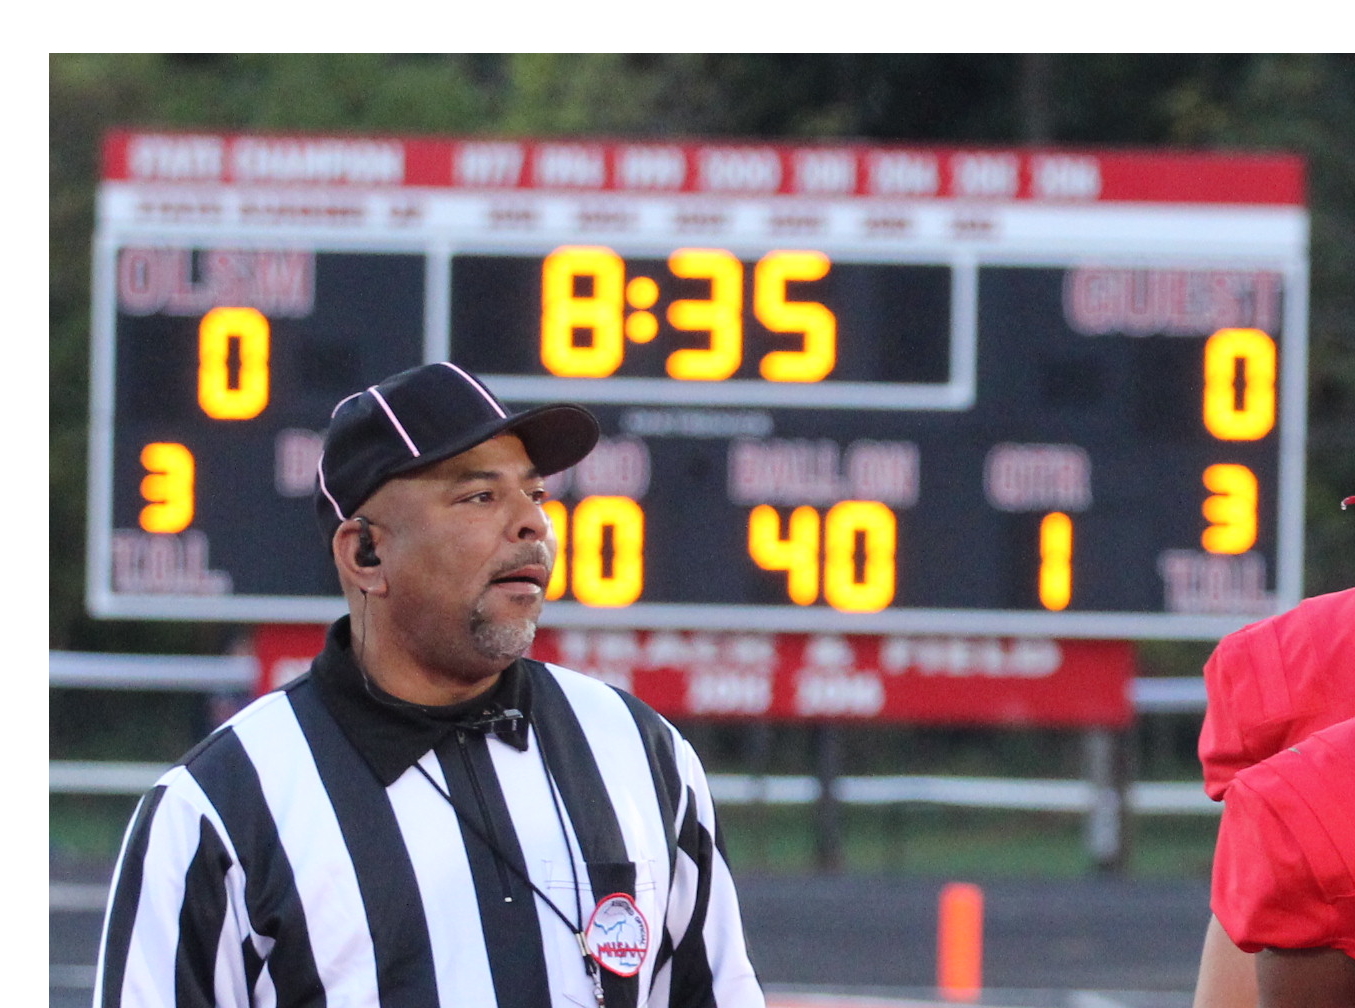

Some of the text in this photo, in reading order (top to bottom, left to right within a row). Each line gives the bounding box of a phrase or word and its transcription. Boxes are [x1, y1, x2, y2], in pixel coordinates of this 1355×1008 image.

[541, 245, 837, 382] 8:35
[1065, 265, 1282, 335] GUEST
[198, 307, 270, 420] 0
[1203, 327, 1277, 441] 0
[139, 442, 195, 534] 3
[1202, 463, 1258, 554] 3
[748, 500, 896, 613] 40
[1039, 511, 1073, 611] 1
[880, 635, 1063, 678] FIELD
